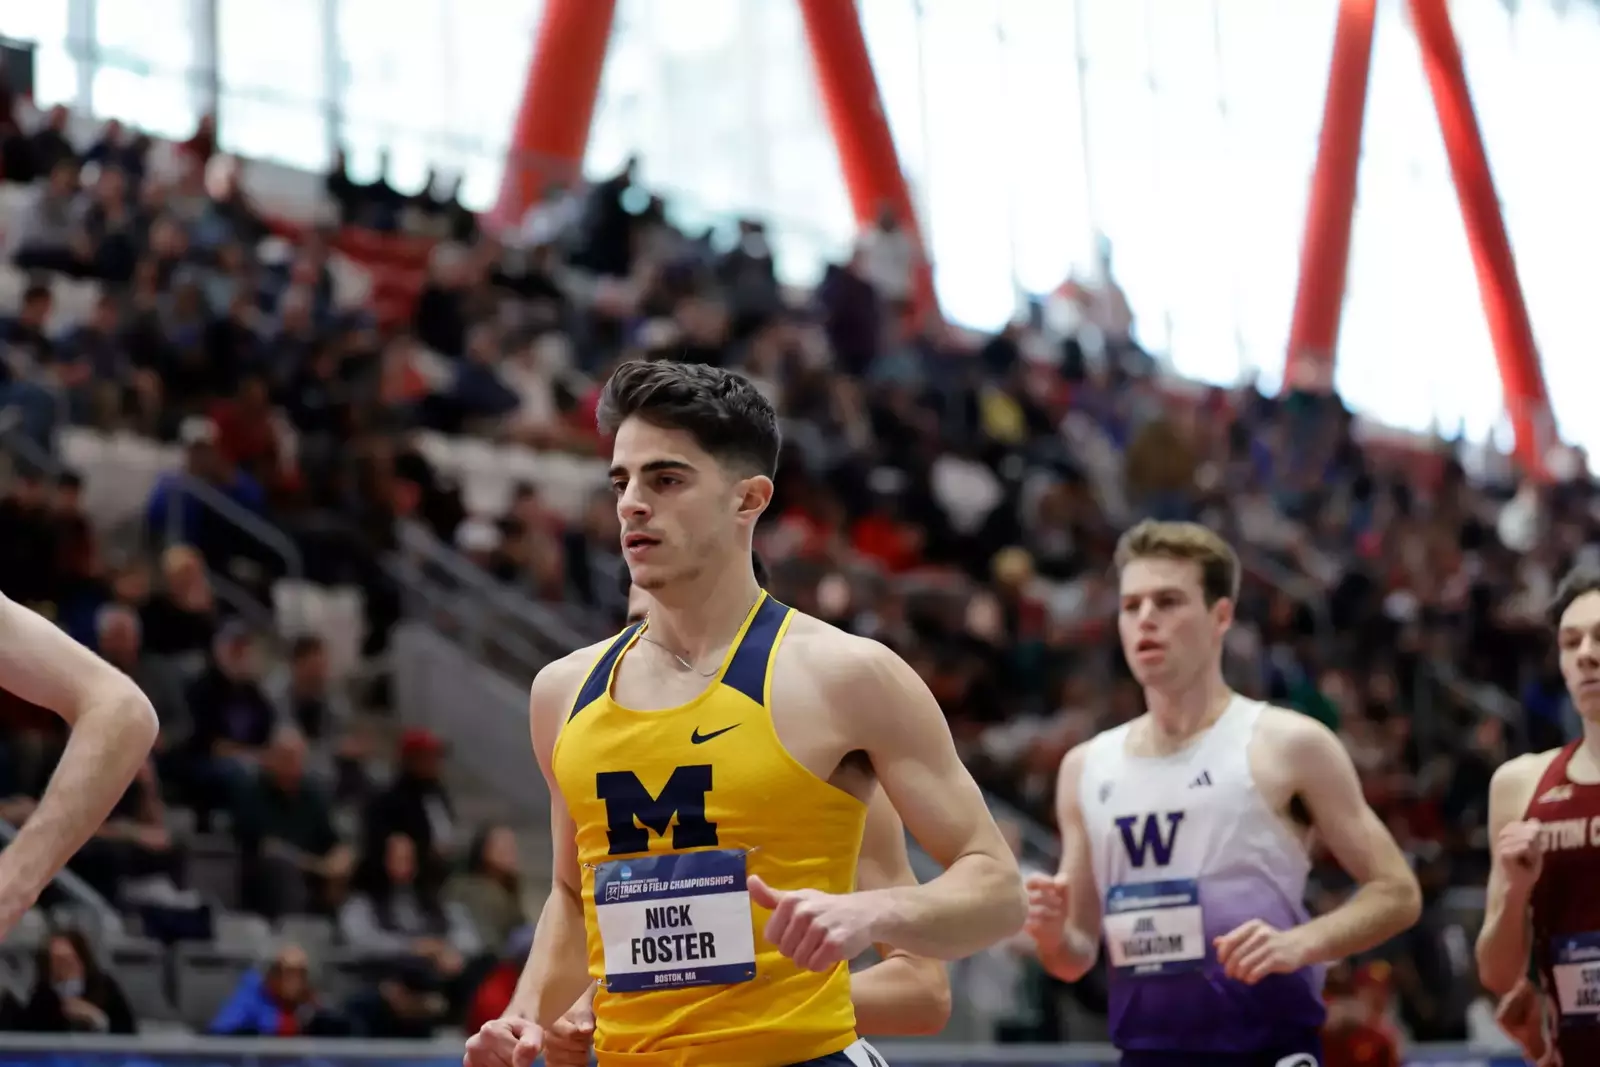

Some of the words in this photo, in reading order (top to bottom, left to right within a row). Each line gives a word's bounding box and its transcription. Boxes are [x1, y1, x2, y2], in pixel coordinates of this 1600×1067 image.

[596, 764, 719, 855] M
[1114, 810, 1185, 868] W
[1539, 817, 1588, 852] STON
[620, 883, 642, 895] TRACK
[648, 880, 669, 892] FIELD
[669, 875, 734, 890] CHAMPIONSHIPS
[645, 904, 693, 930] NICK
[631, 931, 716, 965] FOSTER
[654, 973, 684, 984] BOSTON,
[685, 971, 697, 981] MA
